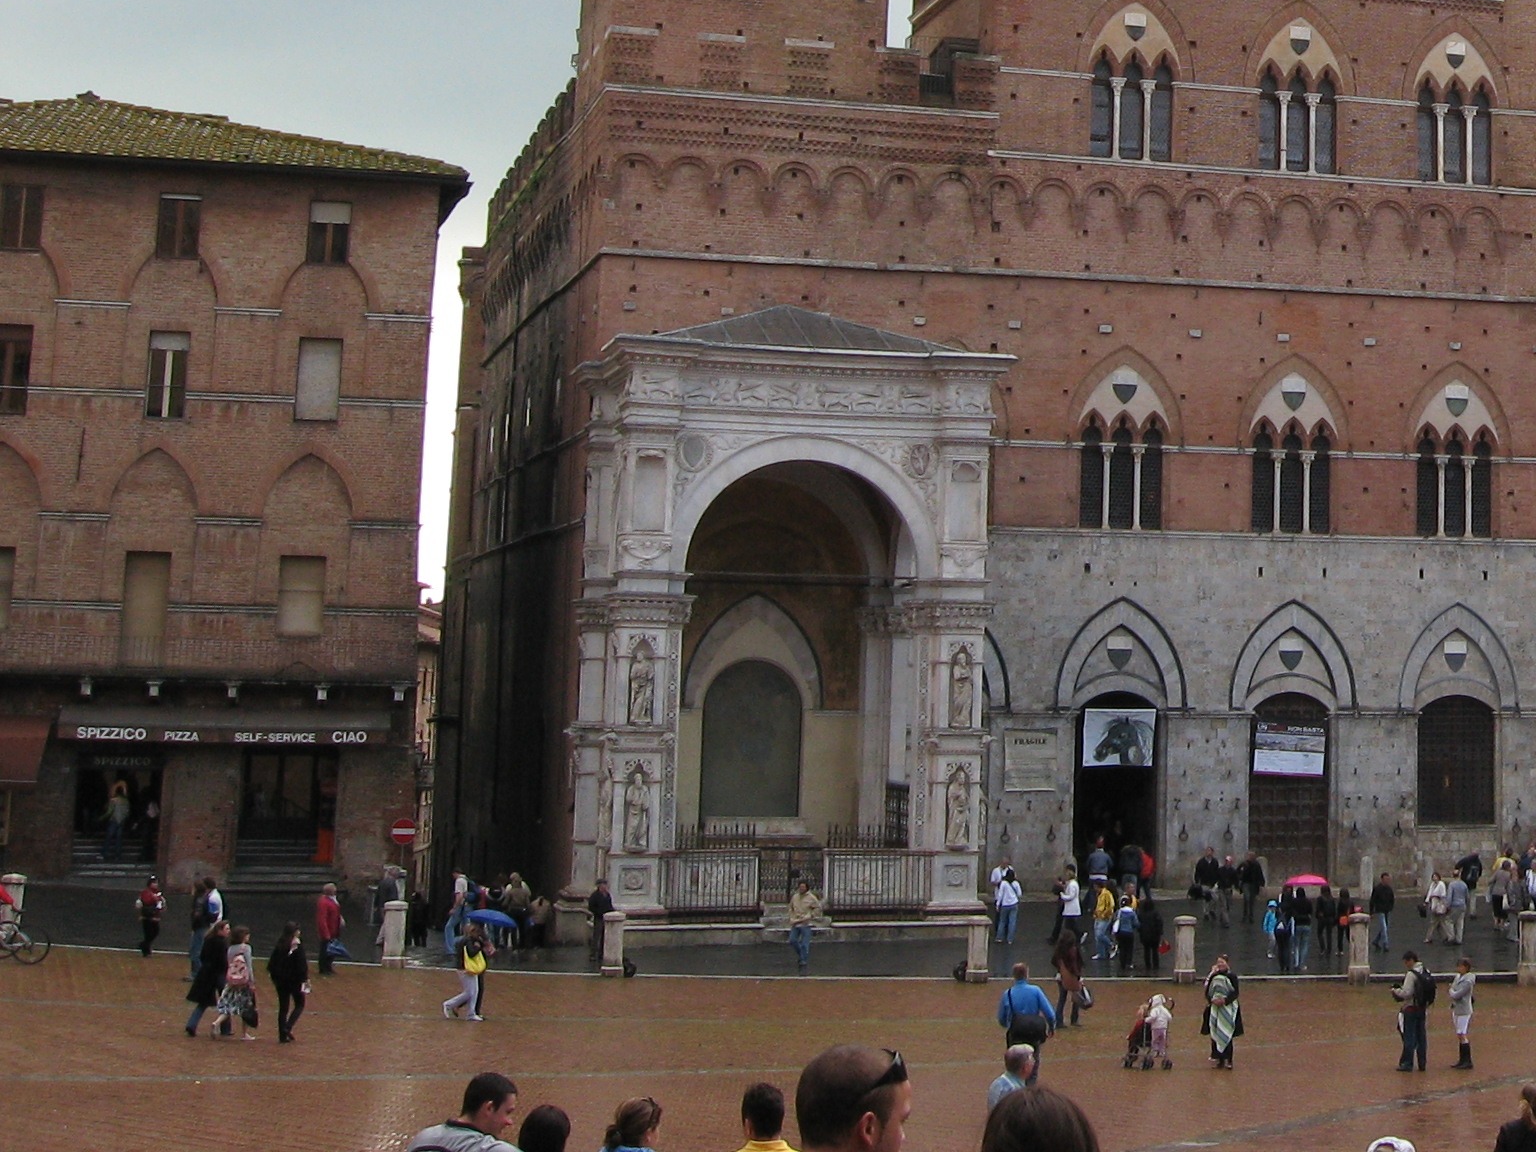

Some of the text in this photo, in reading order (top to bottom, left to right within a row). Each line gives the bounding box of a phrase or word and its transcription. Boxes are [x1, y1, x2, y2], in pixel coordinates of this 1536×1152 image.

[76, 726, 200, 742] SPIZZICO PIZZA
[234, 731, 367, 743] SELF-SERVICE CIAO
[94, 756, 150, 766] SPIZZICO
